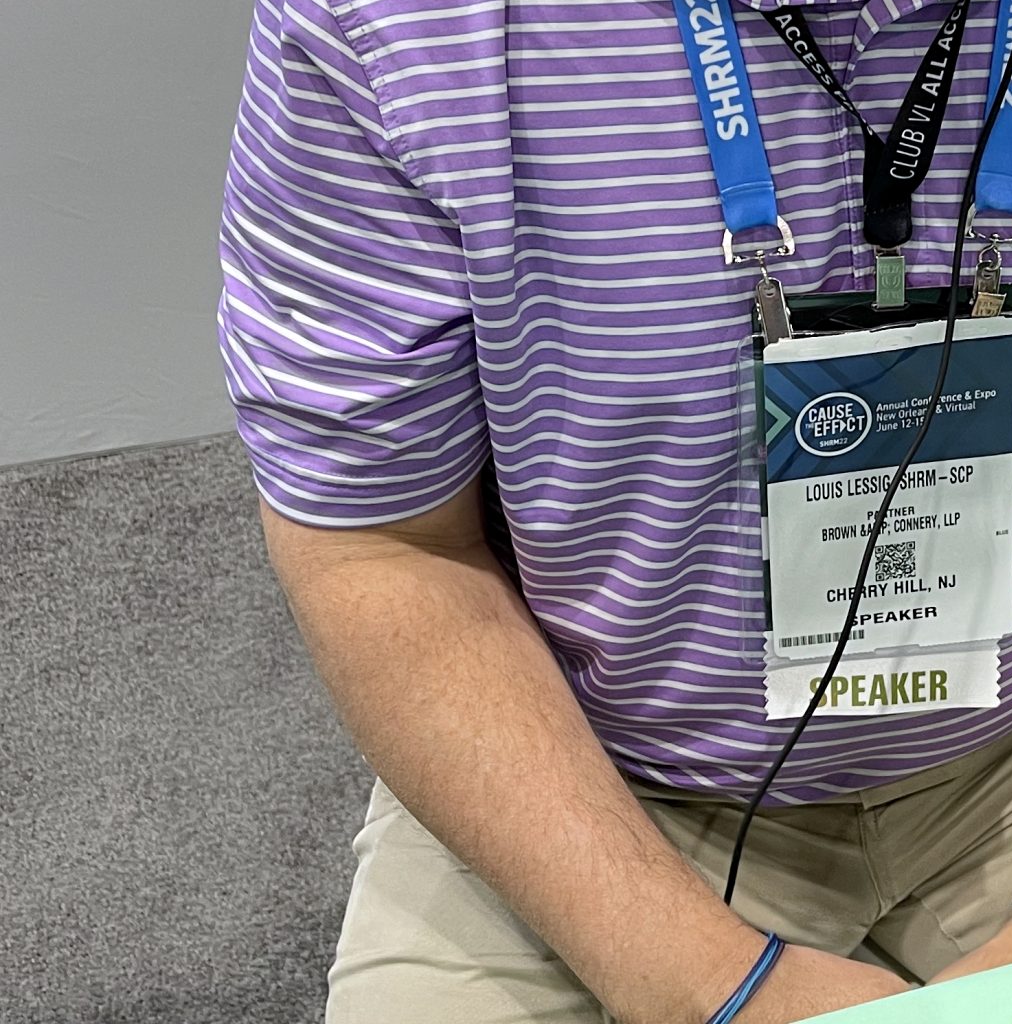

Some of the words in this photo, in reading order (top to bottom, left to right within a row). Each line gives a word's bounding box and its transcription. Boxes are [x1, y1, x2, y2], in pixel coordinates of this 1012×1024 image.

[774, 14, 834, 86] ACCESS
[921, 57, 948, 96] ALL
[908, 103, 935, 122] VL
[890, 129, 925, 180] CLUB
[876, 400, 909, 412] Annual
[911, 393, 962, 407] Confrence
[964, 391, 972, 400] &
[974, 389, 997, 400] Expo
[808, 403, 853, 423] CAUSE
[876, 413, 896, 422] New
[898, 408, 928, 419] Orlean
[935, 404, 943, 414] &
[945, 401, 976, 413] Virtual
[876, 423, 898, 432] June
[819, 437, 848, 447] SHRM22
[806, 481, 843, 502] LOUIS
[867, 506, 915, 520] PATNER
[822, 524, 857, 541] BROWN
[860, 521, 890, 536] &AP;
[894, 515, 941, 533] CONNERY,
[944, 512, 960, 527] LLP
[827, 583, 888, 603] CHERRY
[894, 578, 932, 595] HILL,
[938, 574, 956, 589] NJ
[851, 606, 938, 626] SPEAKER
[809, 669, 948, 707] SPEAKER
